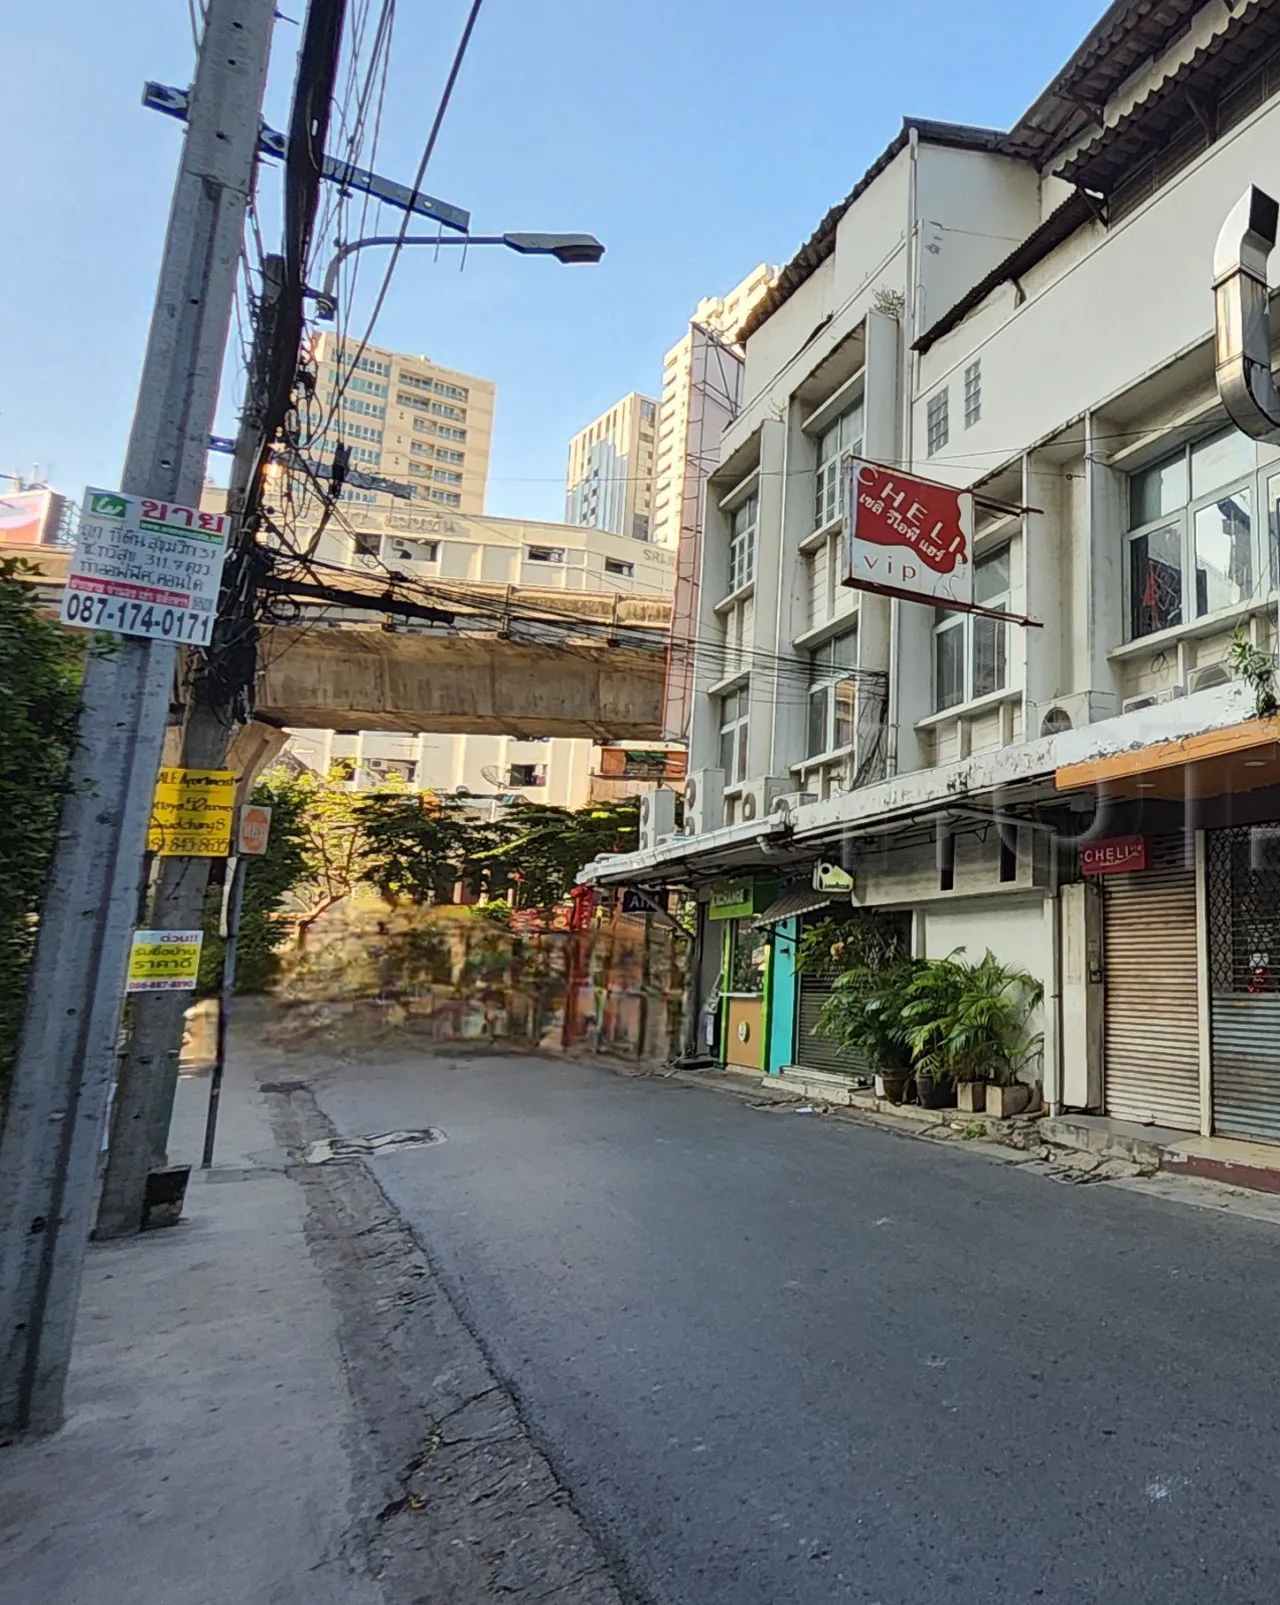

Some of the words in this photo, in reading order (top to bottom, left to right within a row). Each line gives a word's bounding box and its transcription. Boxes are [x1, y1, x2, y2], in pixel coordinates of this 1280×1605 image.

[141, 500, 225, 534] ขาย
[858, 466, 960, 553] CHELI
[864, 556, 917, 581] vip
[66, 593, 210, 642] 087-174-0171
[1084, 845, 1128, 862] CHELI
